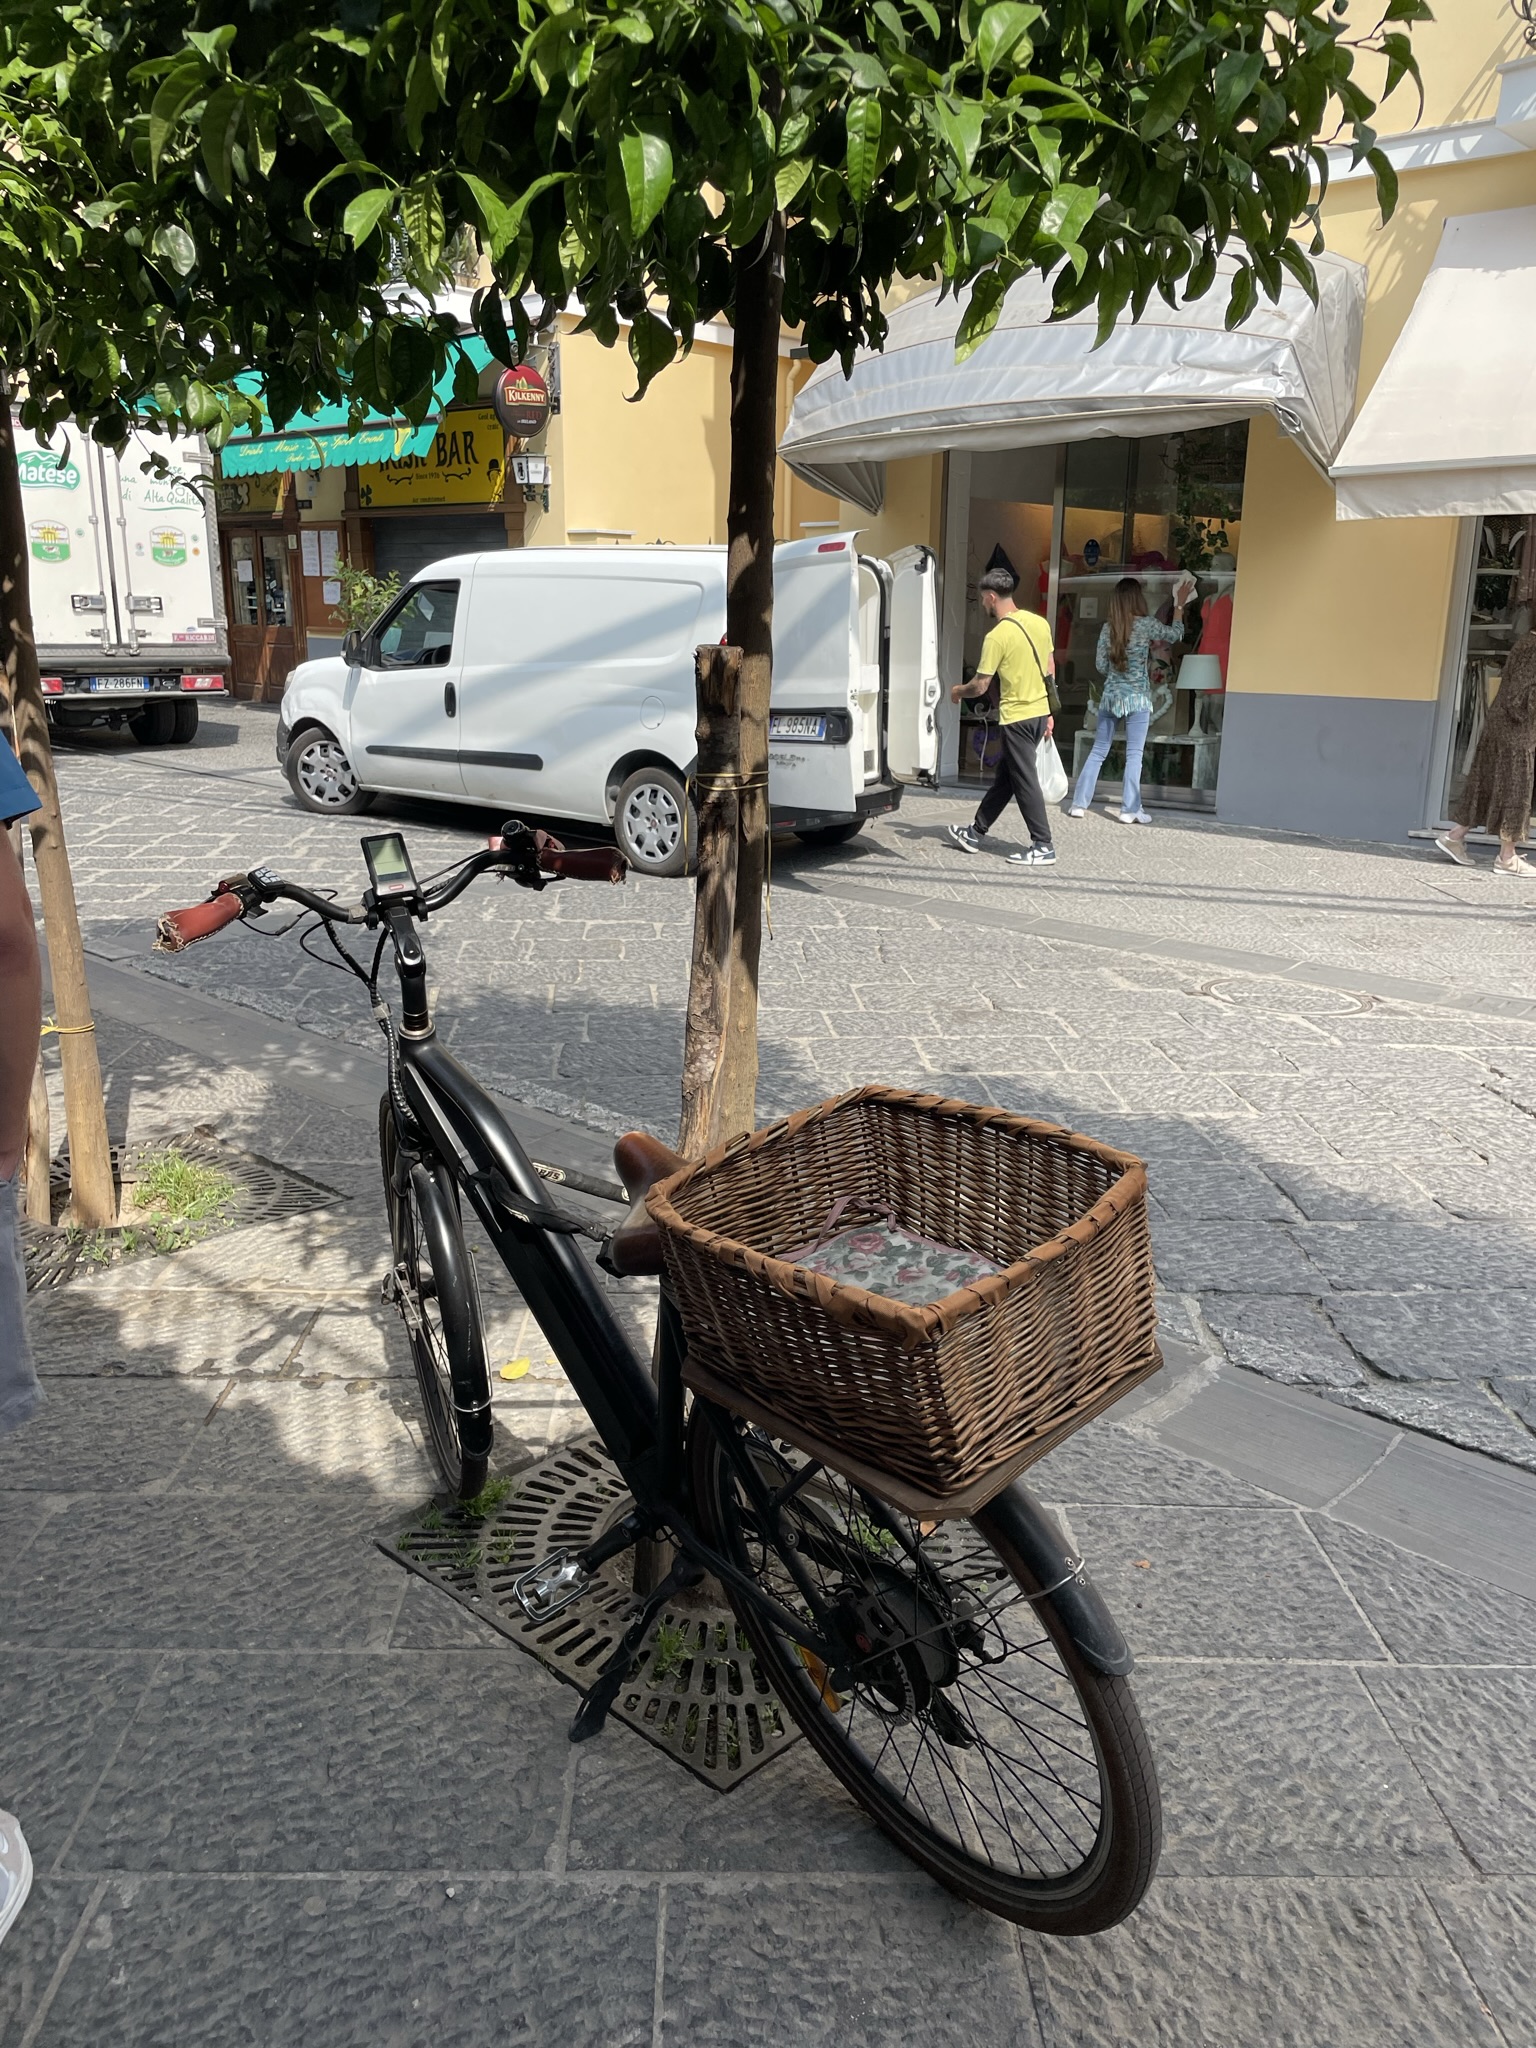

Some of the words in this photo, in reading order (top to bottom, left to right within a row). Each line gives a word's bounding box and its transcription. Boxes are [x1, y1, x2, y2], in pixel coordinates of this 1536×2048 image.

[509, 390, 545, 402] KILKENNY
[435, 430, 479, 468] BAR
[144, 489, 165, 504] Alta
[97, 678, 109, 689] FZ
[113, 678, 143, 689] 286FN
[773, 717, 782, 733] FL
[786, 716, 818, 734] 985NA
